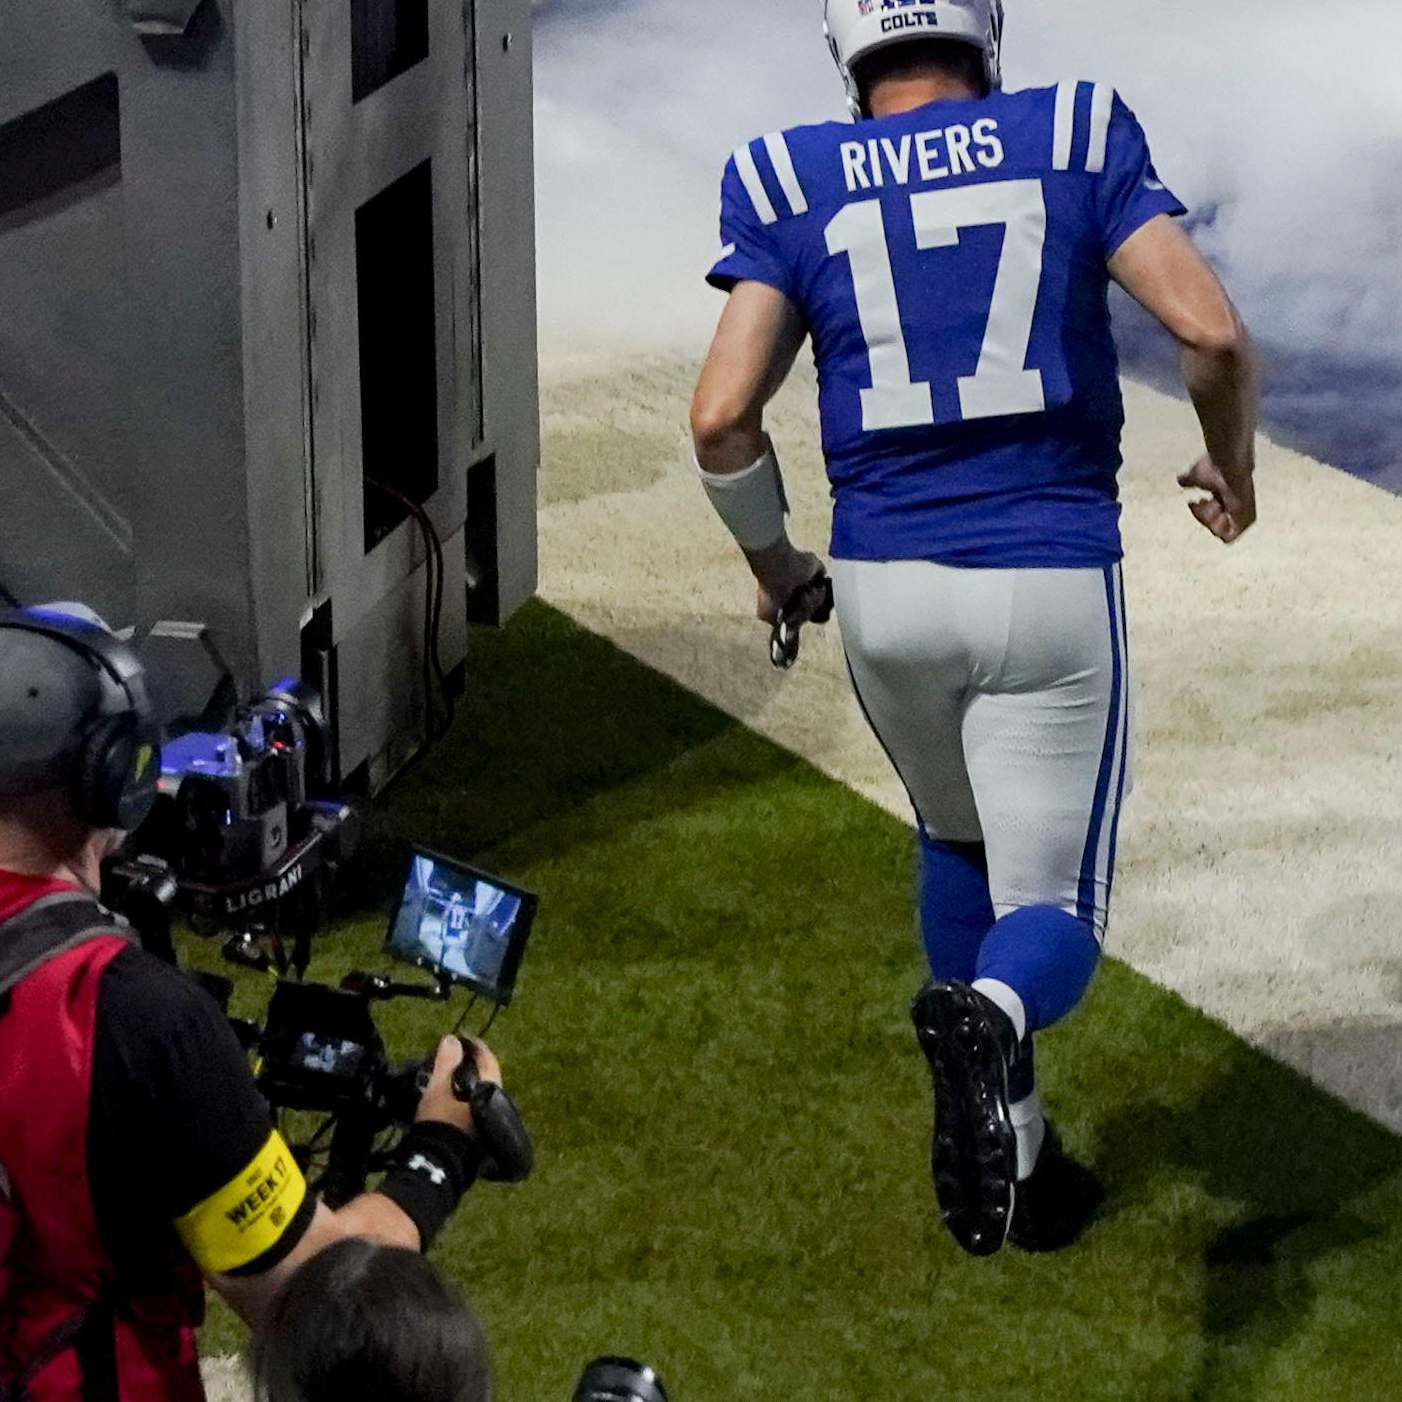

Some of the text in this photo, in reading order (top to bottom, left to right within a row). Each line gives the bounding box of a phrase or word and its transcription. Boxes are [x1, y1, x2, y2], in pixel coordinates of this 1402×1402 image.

[880, 11, 939, 34] COLTS
[840, 117, 1005, 192] RIVERS
[823, 178, 1047, 432] 17
[225, 1172, 278, 1226] WEEK
